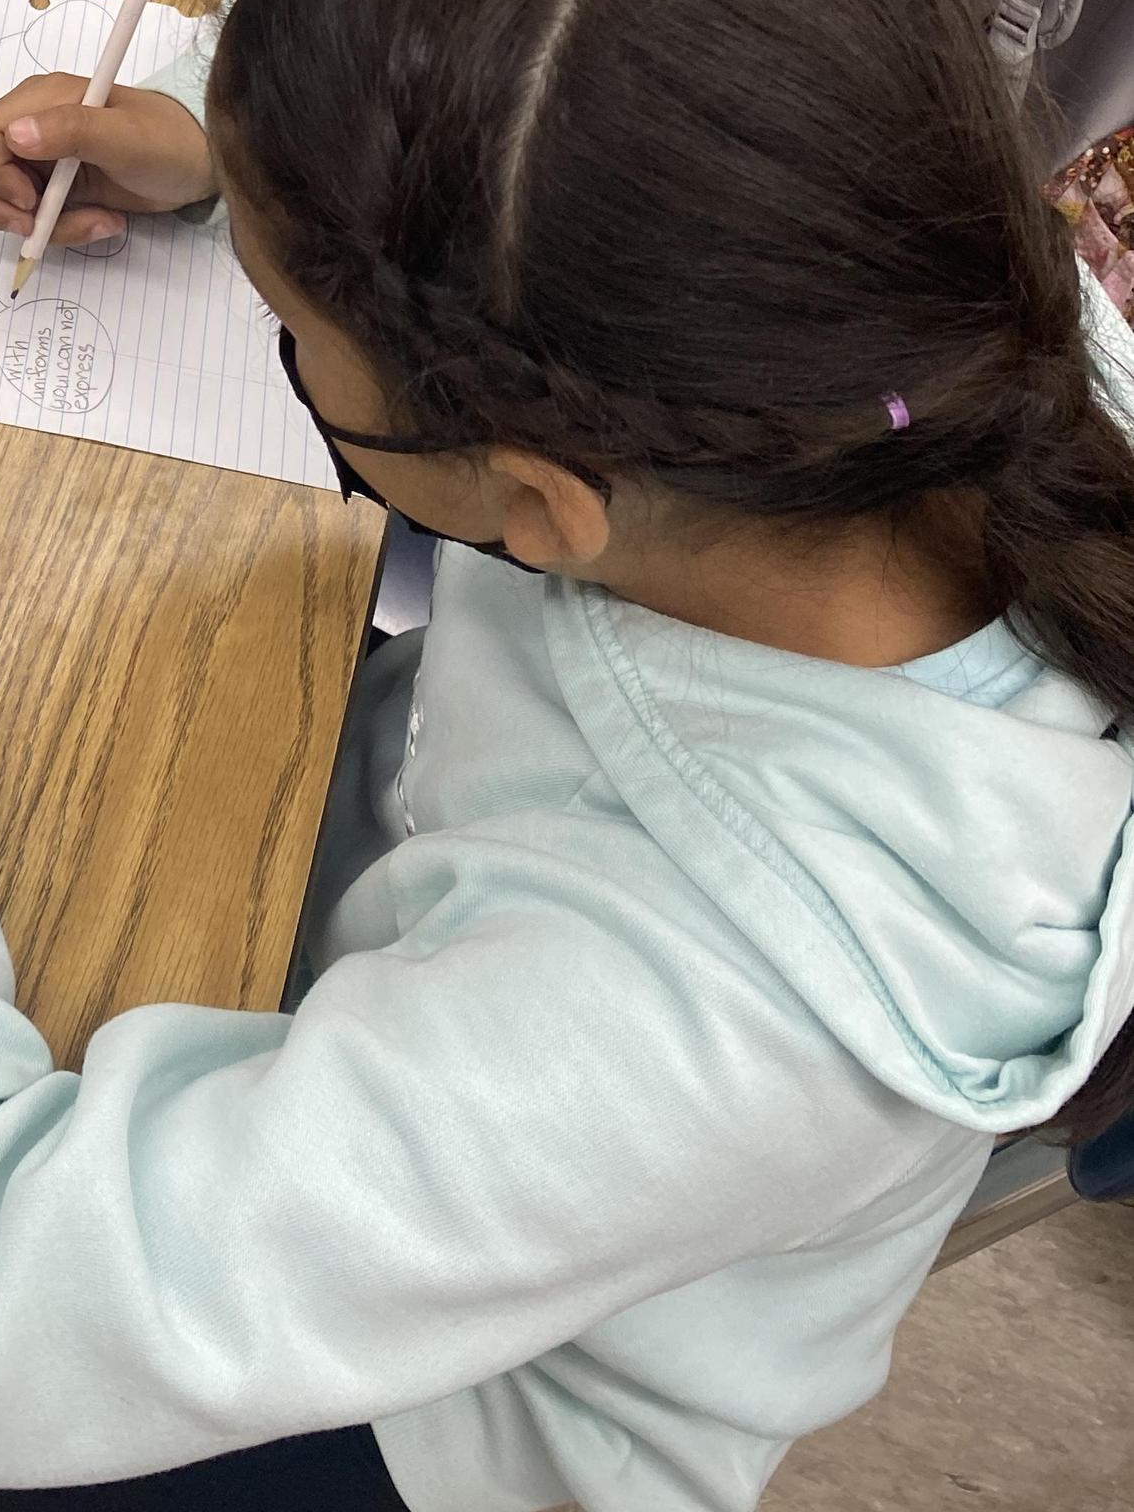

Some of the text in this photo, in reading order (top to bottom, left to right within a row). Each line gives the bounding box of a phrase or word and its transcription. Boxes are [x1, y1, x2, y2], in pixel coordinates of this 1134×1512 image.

[26, 327, 51, 400] uniforms
[49, 300, 79, 410] you can not
[74, 343, 98, 410] express
